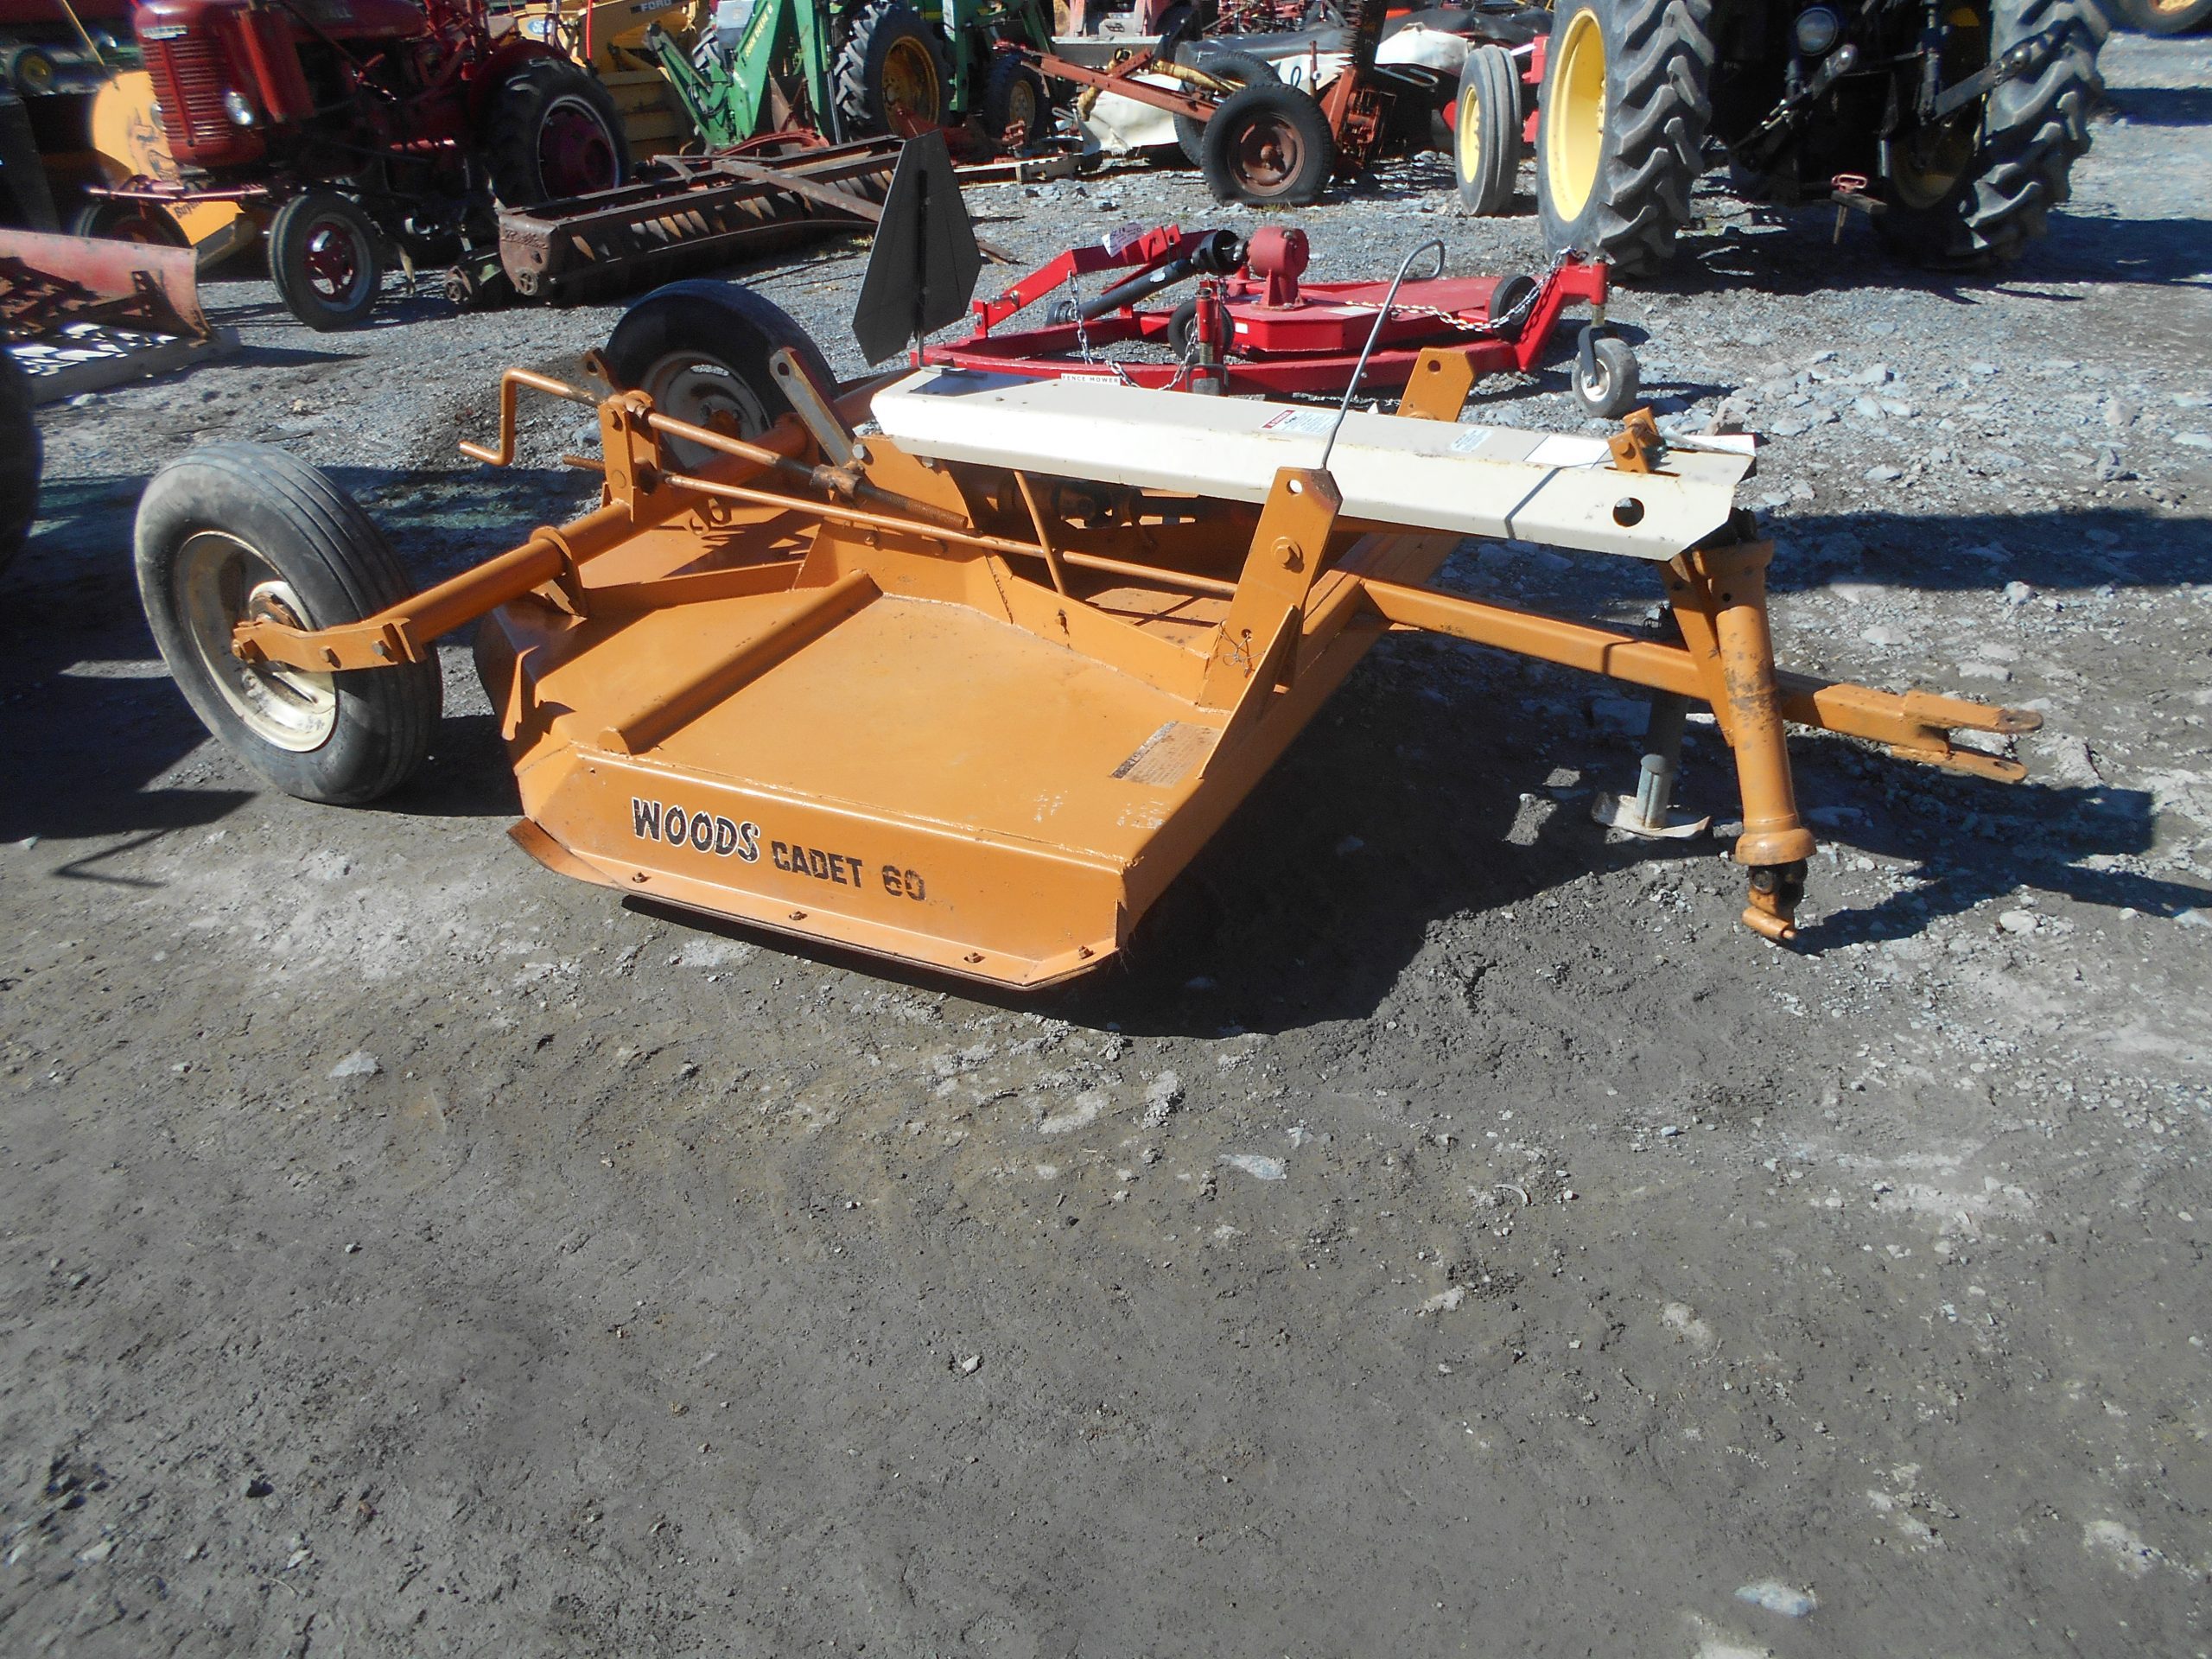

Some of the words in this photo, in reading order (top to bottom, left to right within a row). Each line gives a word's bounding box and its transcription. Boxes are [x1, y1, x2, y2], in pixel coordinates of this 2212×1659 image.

[640, 0, 672, 12] FORD
[632, 797, 760, 863] WOODS
[771, 841, 862, 888] CADET
[881, 865, 927, 902] 60
